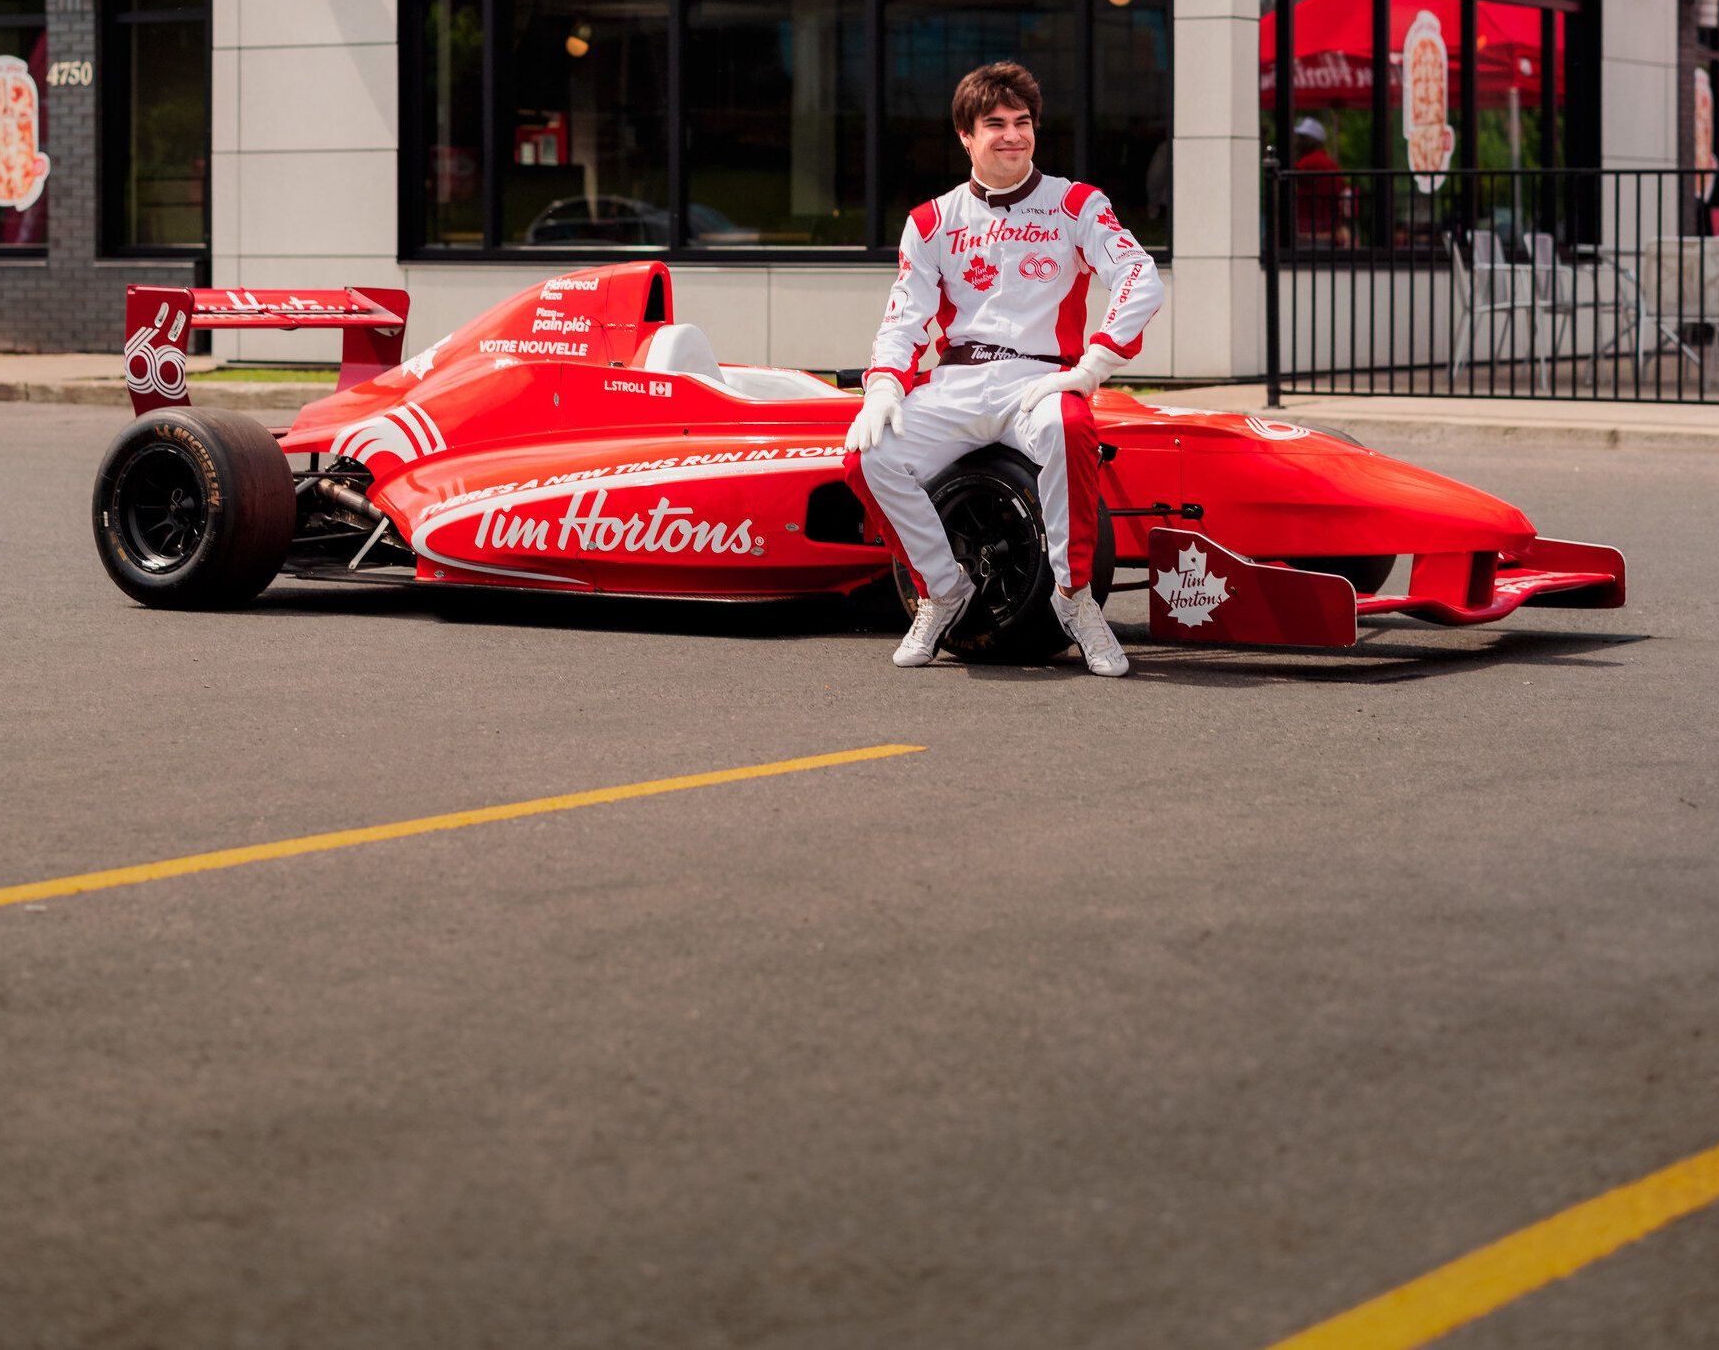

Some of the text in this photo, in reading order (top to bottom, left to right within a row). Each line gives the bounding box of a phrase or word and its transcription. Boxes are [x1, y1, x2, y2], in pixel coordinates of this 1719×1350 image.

[46, 61, 93, 86] 4750
[985, 218, 1059, 245] Hortons
[540, 291, 562, 300] Pizza
[536, 307, 557, 318] Pizza
[532, 316, 562, 334] pain
[480, 340, 588, 356] VOTRE NOUVELLE
[971, 345, 991, 360] Tim
[419, 482, 518, 519] THERE'S
[518, 479, 539, 489] A
[544, 467, 611, 486] NEW
[615, 457, 679, 474] TIMS
[681, 451, 744, 466] RUN
[746, 449, 779, 461] IN
[475, 505, 550, 551] Tim
[1178, 569, 1205, 589] Tim
[1169, 590, 1222, 609] Hortons
